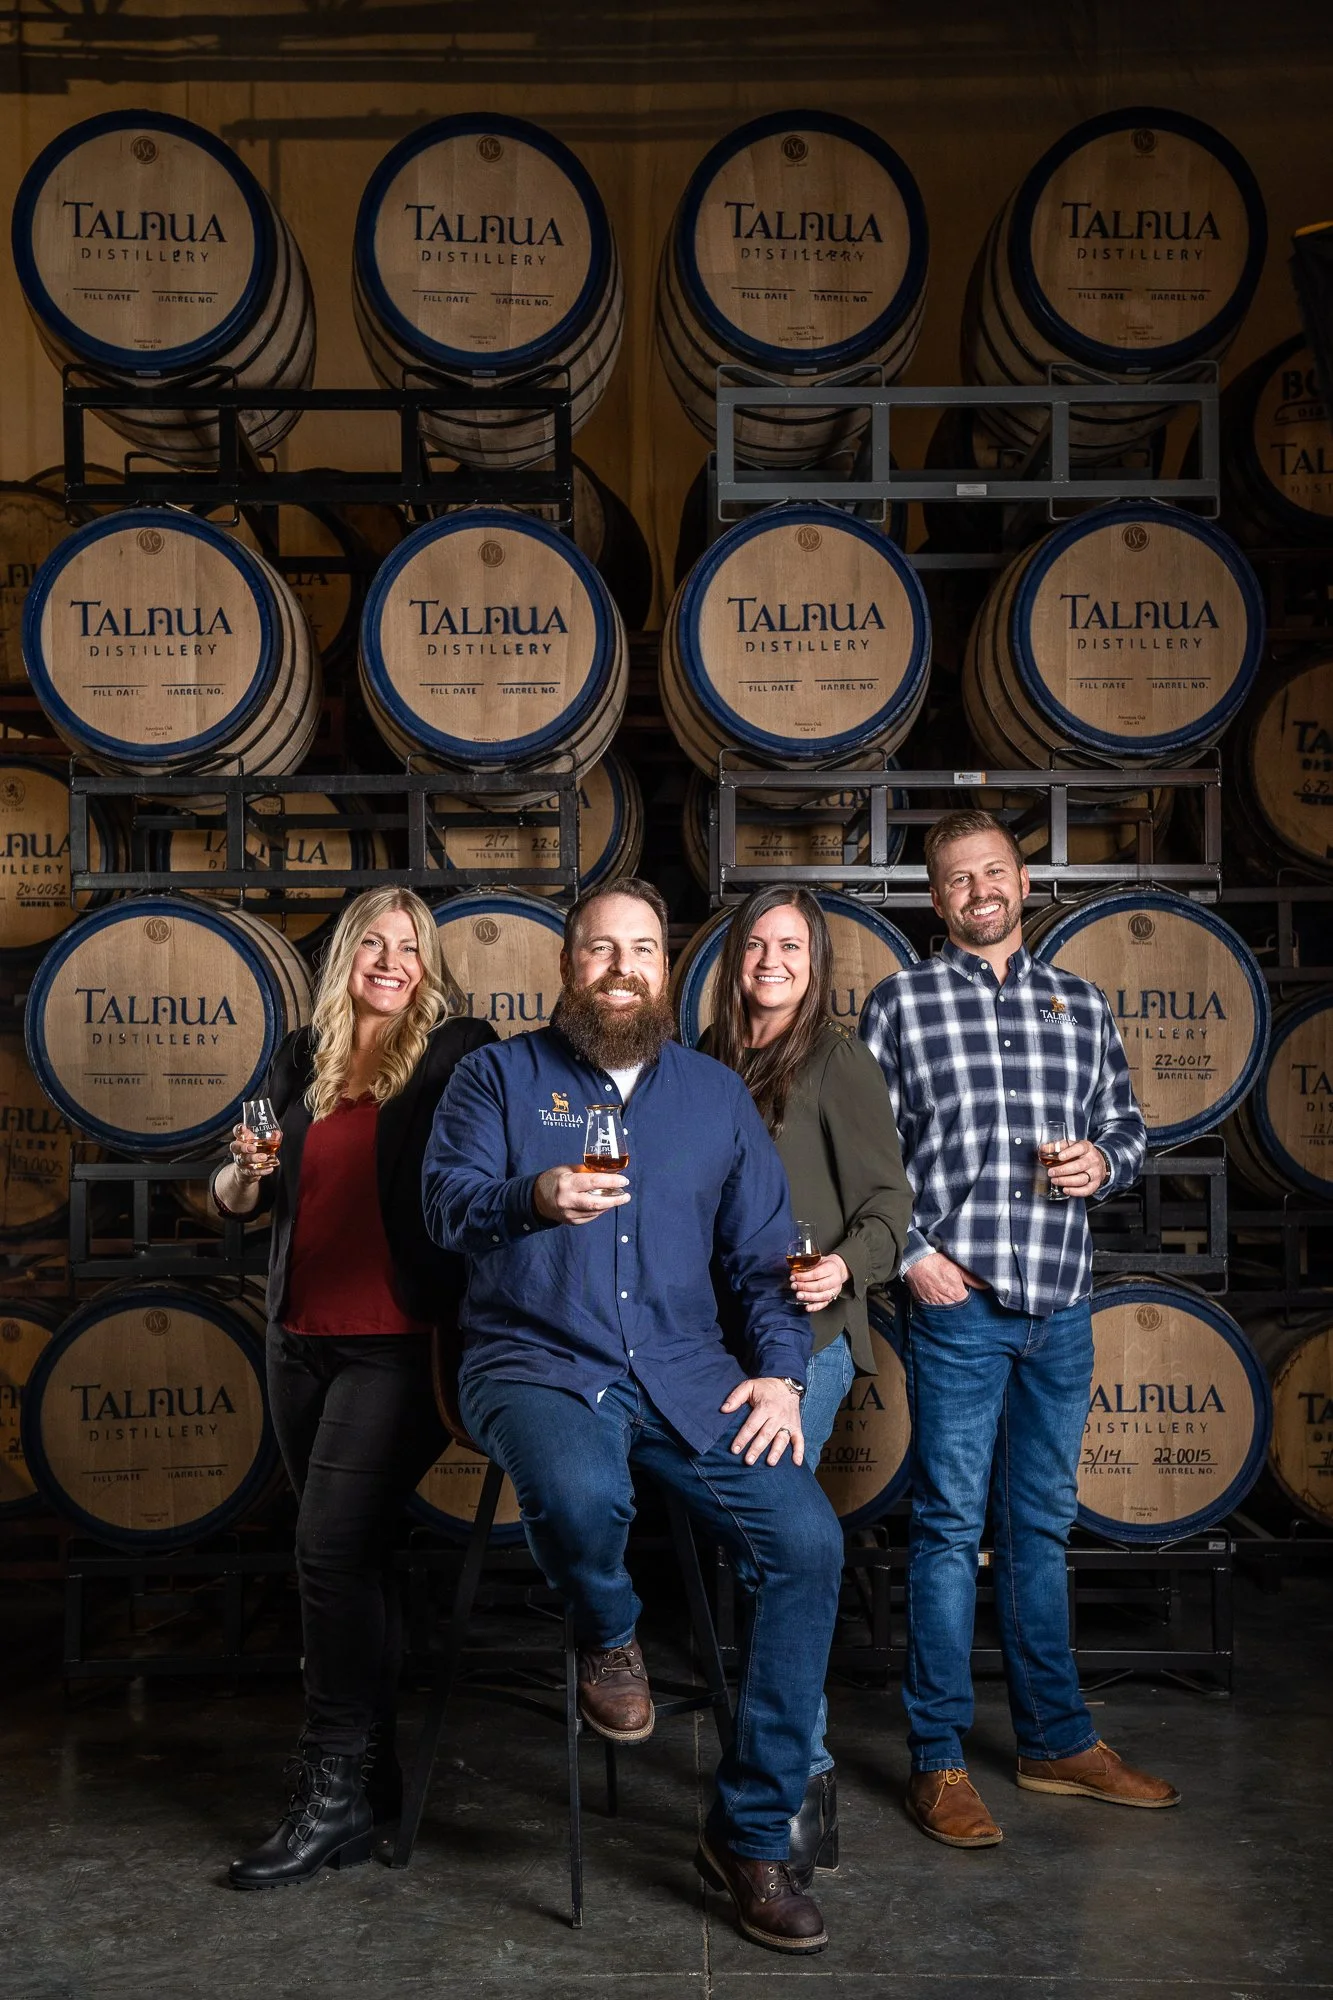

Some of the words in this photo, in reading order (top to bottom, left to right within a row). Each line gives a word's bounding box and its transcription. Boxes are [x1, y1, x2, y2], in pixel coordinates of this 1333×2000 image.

[81, 248, 209, 262] DISTILLERY
[422, 250, 546, 265] DISTILLERY
[741, 248, 864, 262] DISTILLERY
[1077, 248, 1203, 260] DISTILLERY
[158, 295, 194, 303] BARREL
[814, 294, 849, 302] BARREL
[1078, 292, 1096, 300] FILL
[496, 298, 531, 306] BARREL
[427, 643, 552, 655] DISTILLERY
[746, 639, 870, 652] DISTILLERY
[1078, 638, 1202, 649] DISTILLERY
[90, 644, 217, 657] DISTILLERY
[116, 688, 140, 696] DATE
[167, 688, 202, 696] BARREL
[430, 687, 449, 695] FILL
[453, 687, 476, 695] DATE
[502, 686, 538, 694] BARREL
[771, 684, 795, 692] DATE
[821, 683, 855, 691] BARREL
[532, 838, 560, 849] 22-0
[812, 836, 844, 846] 22-0
[466, 992, 547, 1021] LNU
[1101, 988, 1226, 1020] LNUA
[1123, 1027, 1208, 1039] TILLERY
[92, 1033, 219, 1045] DISTILLERY
[1155, 1054, 1211, 1066] 22-0017
[94, 1077, 113, 1085] FILL
[1157, 1072, 1193, 1080] BARREL
[539, 1109, 584, 1123] TALNUA
[543, 1120, 580, 1128] DISTILLERY
[1088, 1384, 1226, 1414] ALNUA
[89, 1423, 218, 1442] DISTILLERY
[1082, 1445, 1121, 1468] 3/14
[1154, 1447, 1211, 1464] 22-0015
[168, 1470, 203, 1479] BARREL
[1107, 1467, 1132, 1475] DATE
[93, 1474, 112, 1482] FILL
[116, 1473, 140, 1481] DATE
